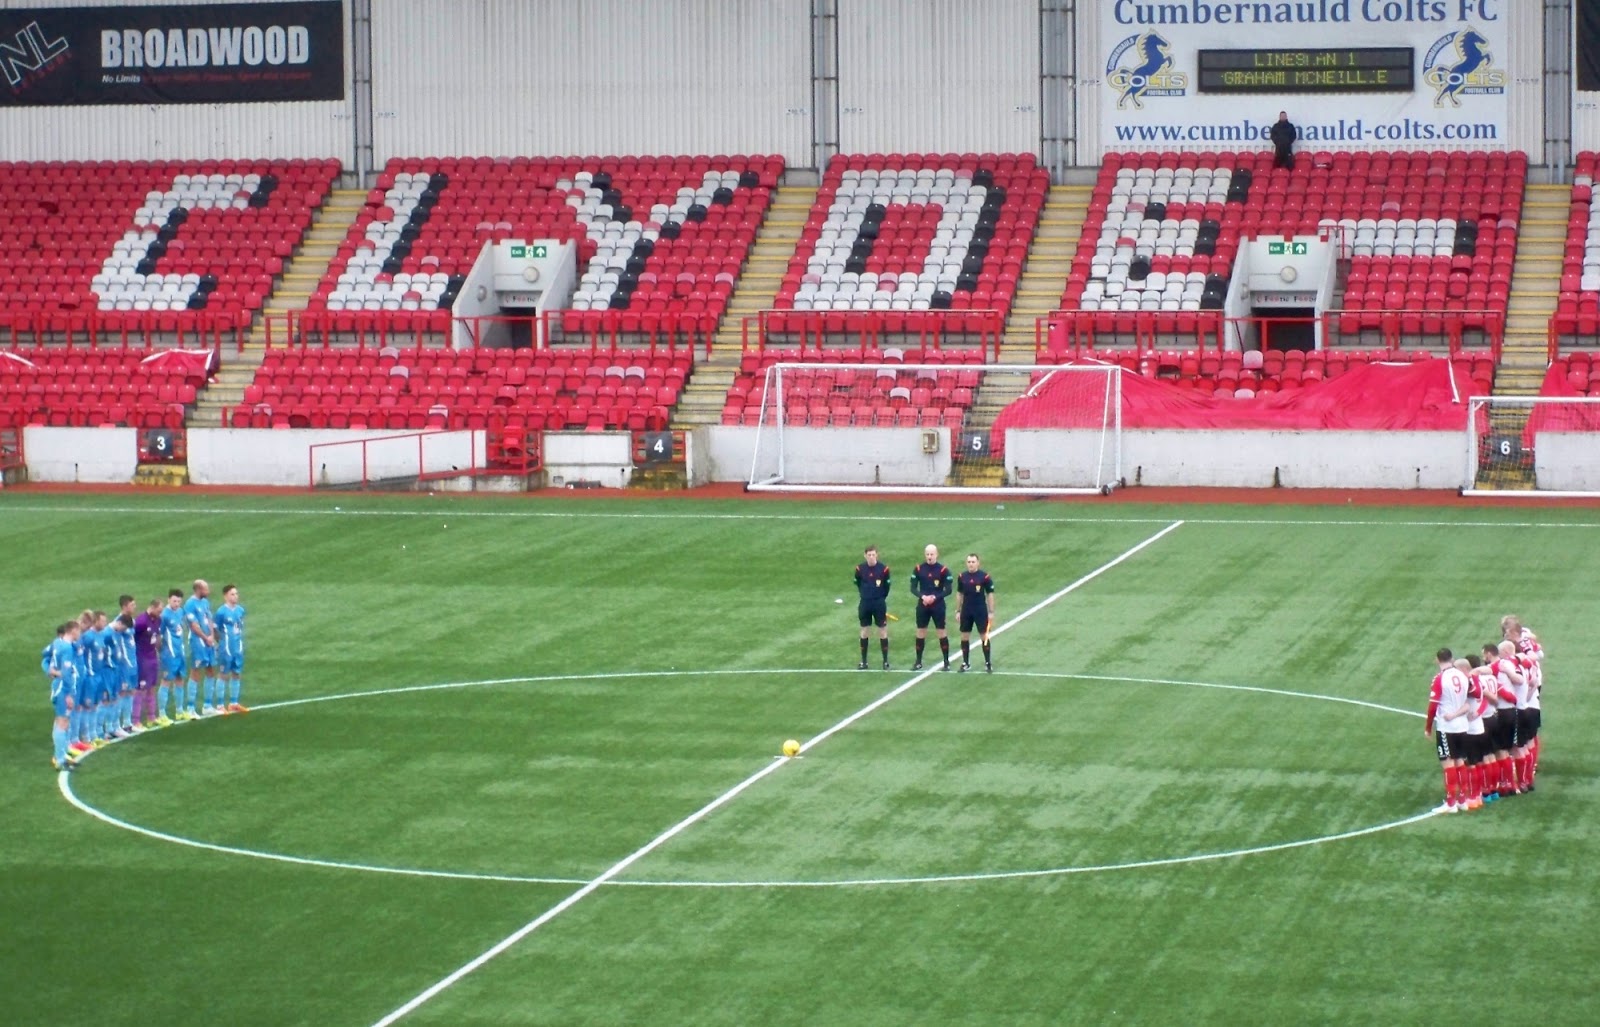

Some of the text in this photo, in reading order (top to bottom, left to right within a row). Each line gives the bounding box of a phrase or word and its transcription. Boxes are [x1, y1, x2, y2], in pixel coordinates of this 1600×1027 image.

[1114, 0, 1497, 24] Cumbernauld Colts FC
[0, 21, 69, 86] NL
[101, 26, 309, 68] BROADWOOD
[1348, 53, 1356, 65] 1
[102, 75, 114, 83] No
[116, 74, 141, 83] Limits
[1111, 73, 1184, 87] COLTS
[1223, 71, 1285, 85] GRAHAM
[1428, 71, 1503, 85] COLTS
[157, 435, 166, 450] 3
[653, 439, 664, 453] 4
[972, 436, 982, 450] 5
[1500, 440, 1511, 455] 6
[1452, 675, 1462, 694] 9
